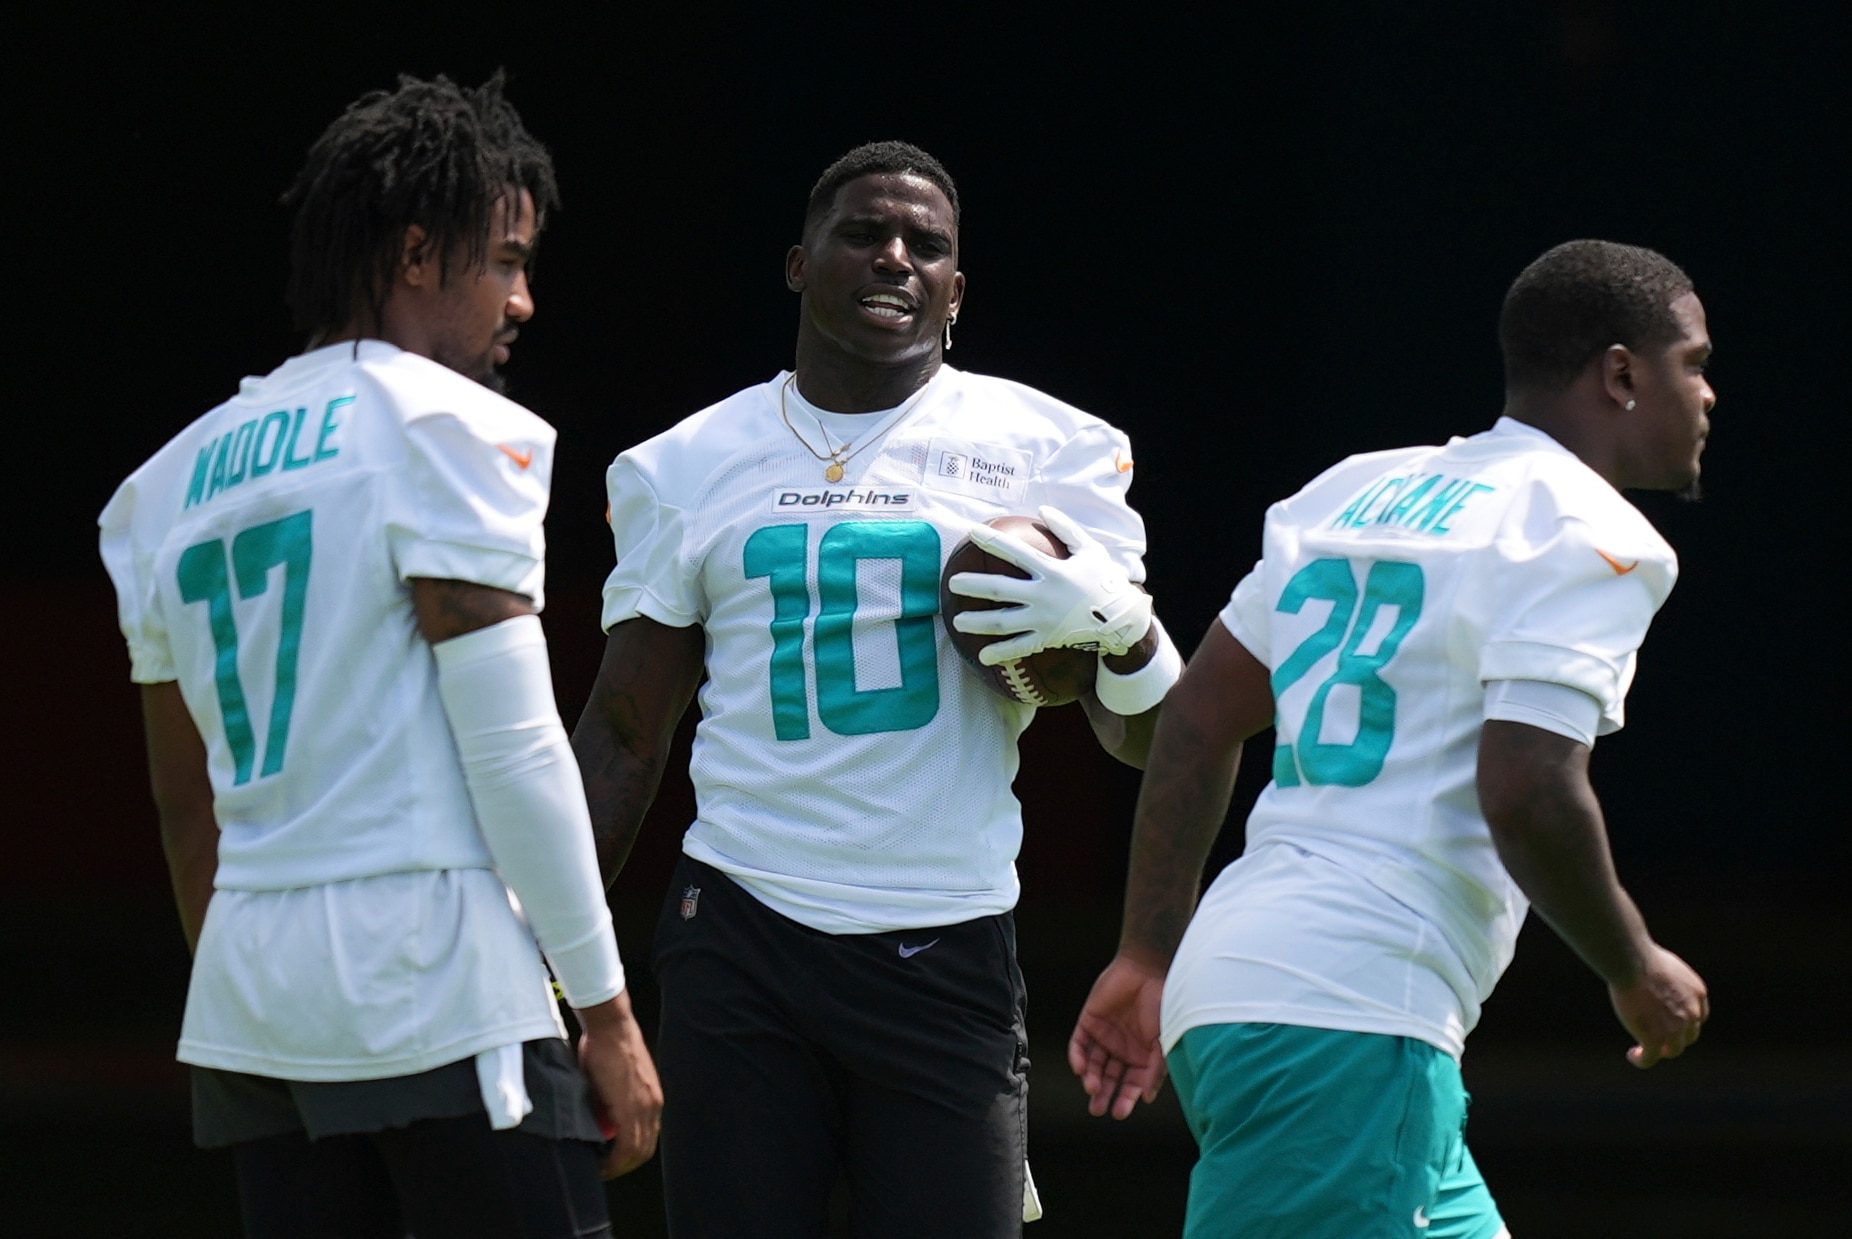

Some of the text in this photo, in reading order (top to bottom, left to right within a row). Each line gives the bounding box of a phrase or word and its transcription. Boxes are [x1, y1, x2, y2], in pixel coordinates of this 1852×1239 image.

[778, 489, 909, 507] Dolphins
[969, 471, 1010, 489] Health
[971, 457, 1015, 476] Baptist
[177, 509, 312, 786] 17
[743, 520, 941, 741] 10
[1271, 558, 1425, 788] 28
